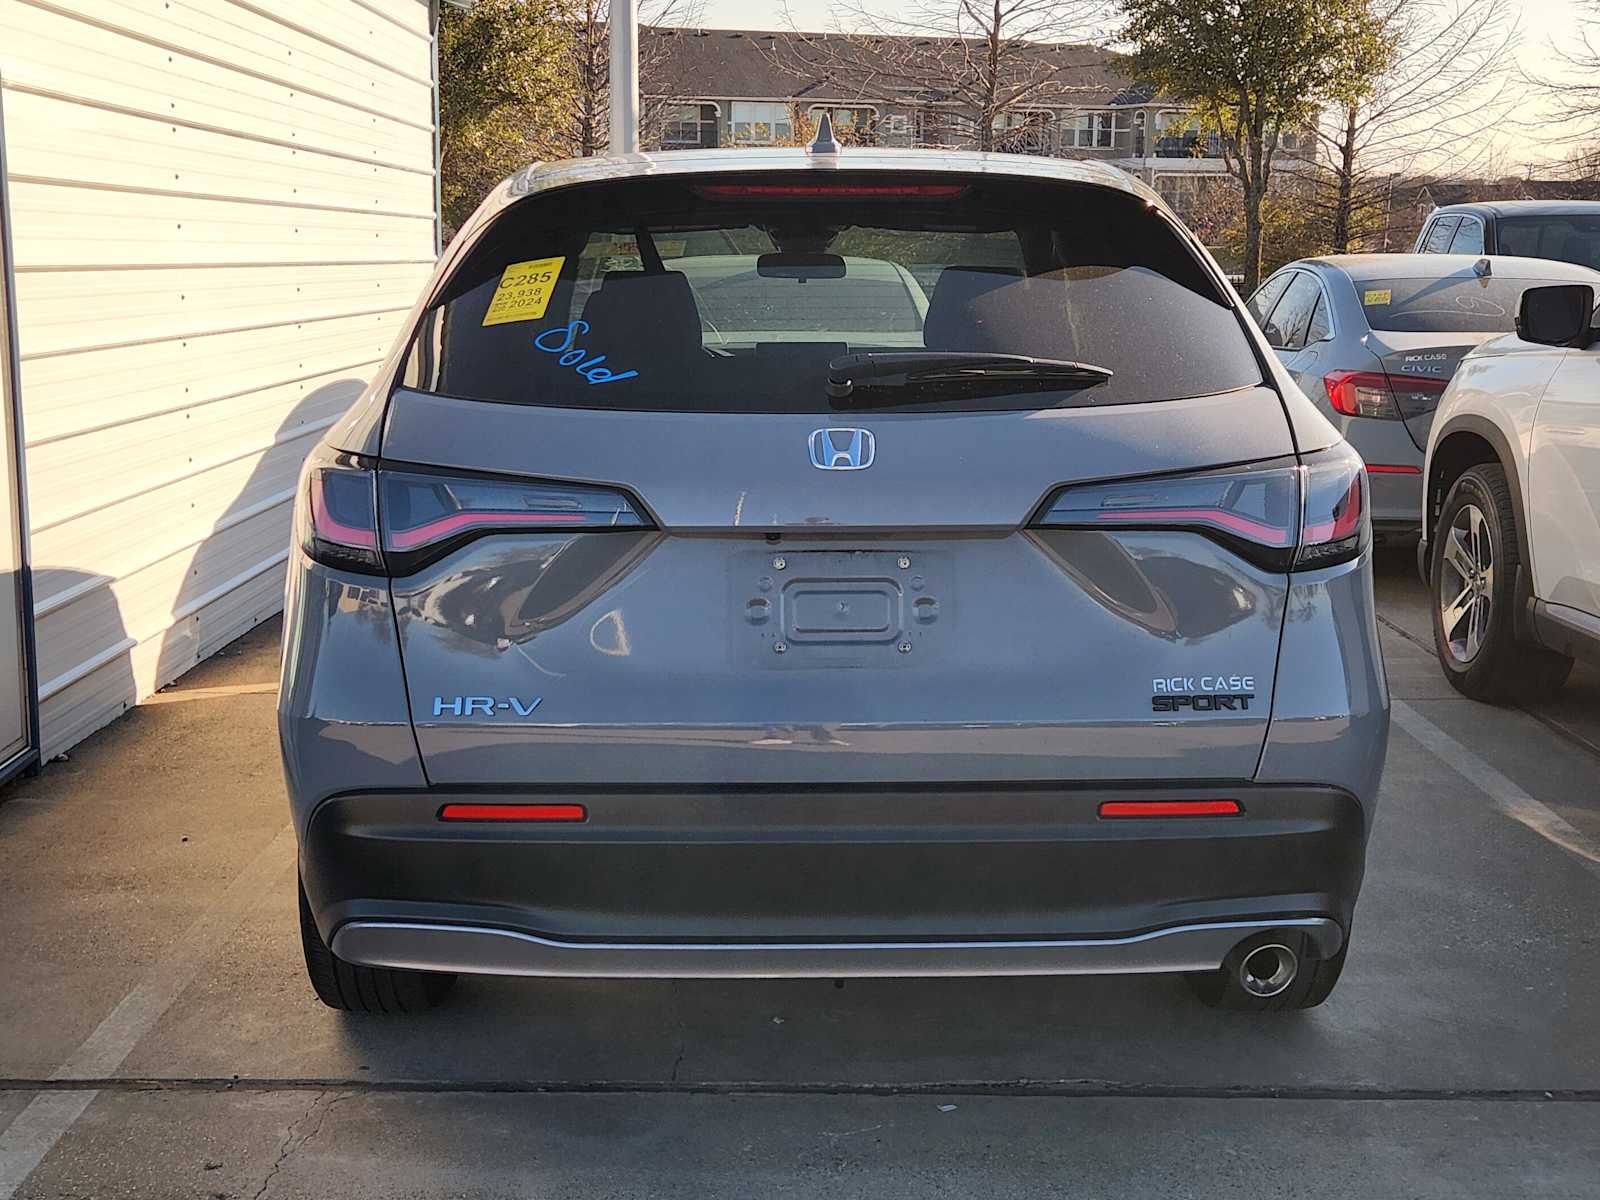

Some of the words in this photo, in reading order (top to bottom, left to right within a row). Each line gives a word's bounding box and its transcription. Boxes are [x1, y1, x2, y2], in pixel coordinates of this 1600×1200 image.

[499, 271, 552, 289] C285
[509, 297, 542, 309] 2024
[534, 320, 639, 384] Sold
[1401, 364, 1442, 373] CIVIC
[1152, 677, 1195, 692] RICK
[1201, 676, 1255, 691] CASE
[433, 696, 542, 716] HR-V
[1152, 693, 1255, 712] SPORT
